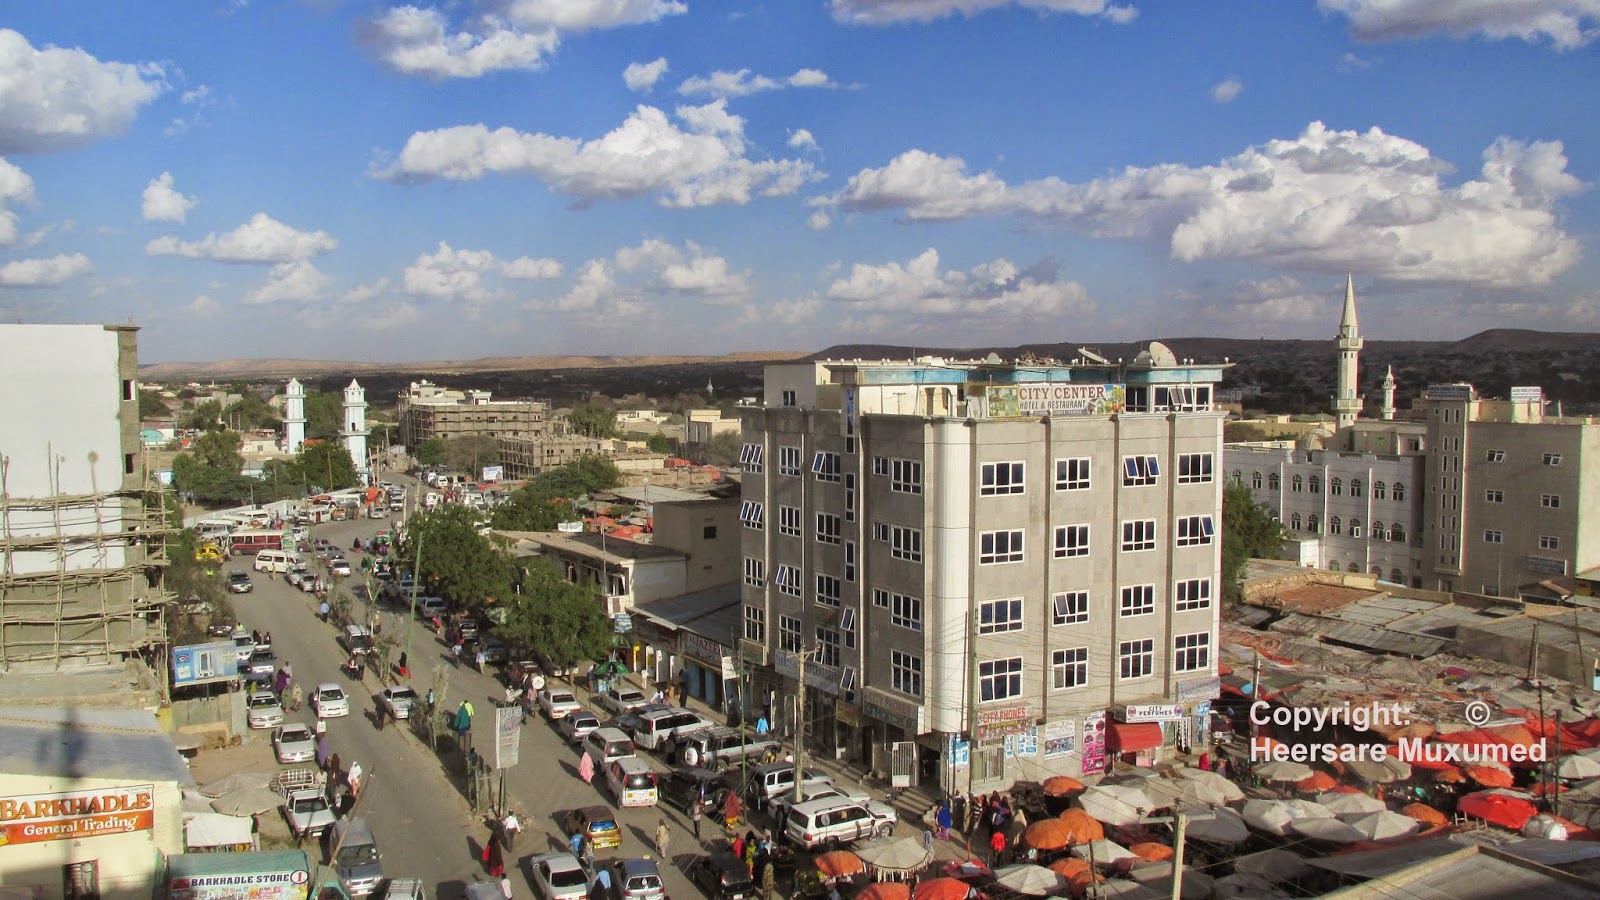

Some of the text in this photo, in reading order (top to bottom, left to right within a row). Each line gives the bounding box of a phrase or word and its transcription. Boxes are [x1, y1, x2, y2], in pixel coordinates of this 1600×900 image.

[1019, 386, 1105, 400] CITY CENTER
[1020, 400, 1086, 410] HOTEL & RESTAURANT
[983, 707, 1026, 723] CITY PHONES
[1138, 709, 1173, 717] PERFUMES
[0, 792, 151, 820] BARKHADLE
[24, 821, 77, 836] General
[80, 816, 139, 831] Trading
[191, 875, 254, 887] BARKHADLE
[256, 874, 290, 883] STORE
